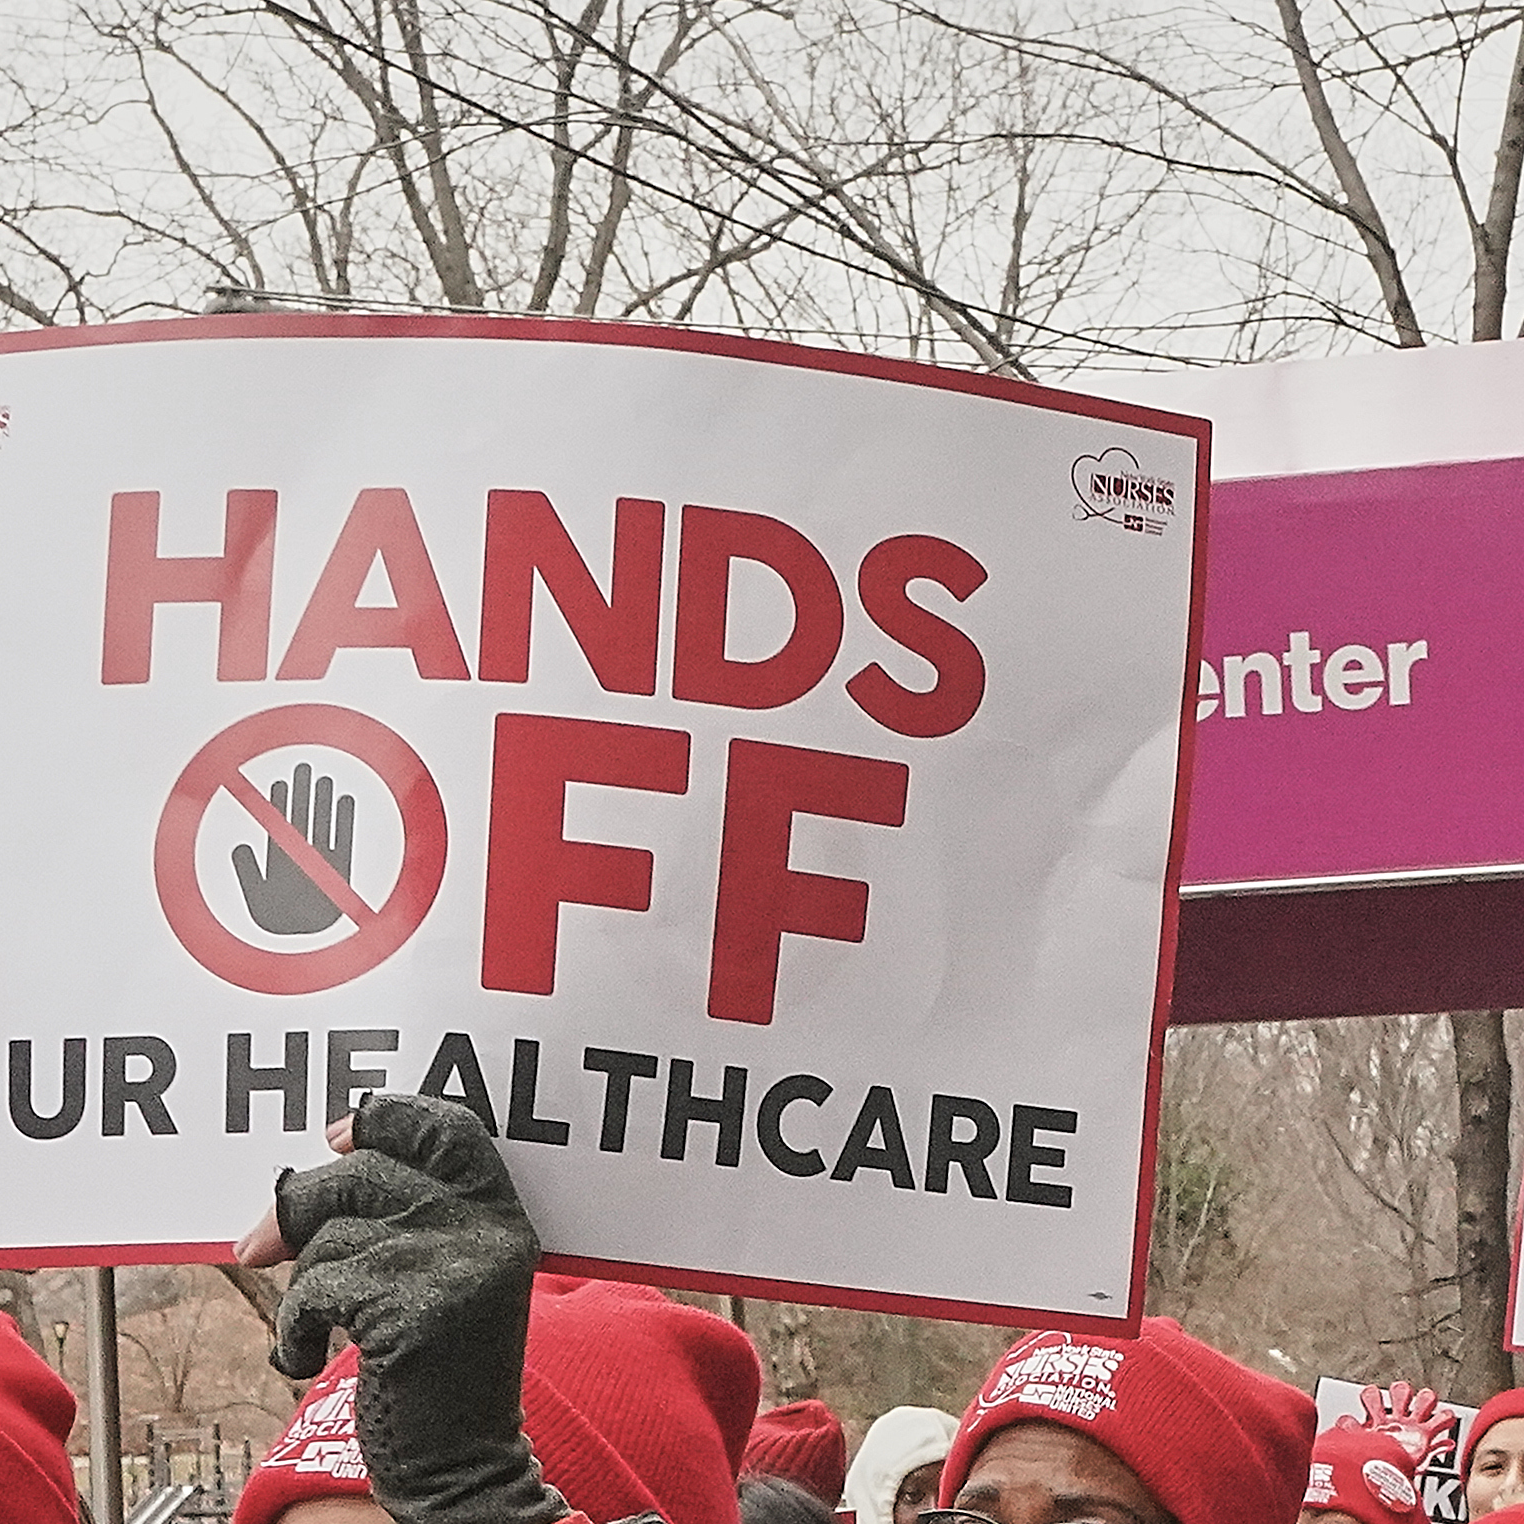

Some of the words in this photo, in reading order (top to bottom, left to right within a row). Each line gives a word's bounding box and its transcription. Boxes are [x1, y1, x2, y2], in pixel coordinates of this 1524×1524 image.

[1090, 473, 1175, 506] NURSES
[101, 487, 988, 738] HANDS
[154, 702, 910, 1026] OFF
[224, 1029, 1078, 1208] HEALTHCARE
[995, 1353, 1119, 1392] NURSES
[1049, 1399, 1097, 1420] UNITED
